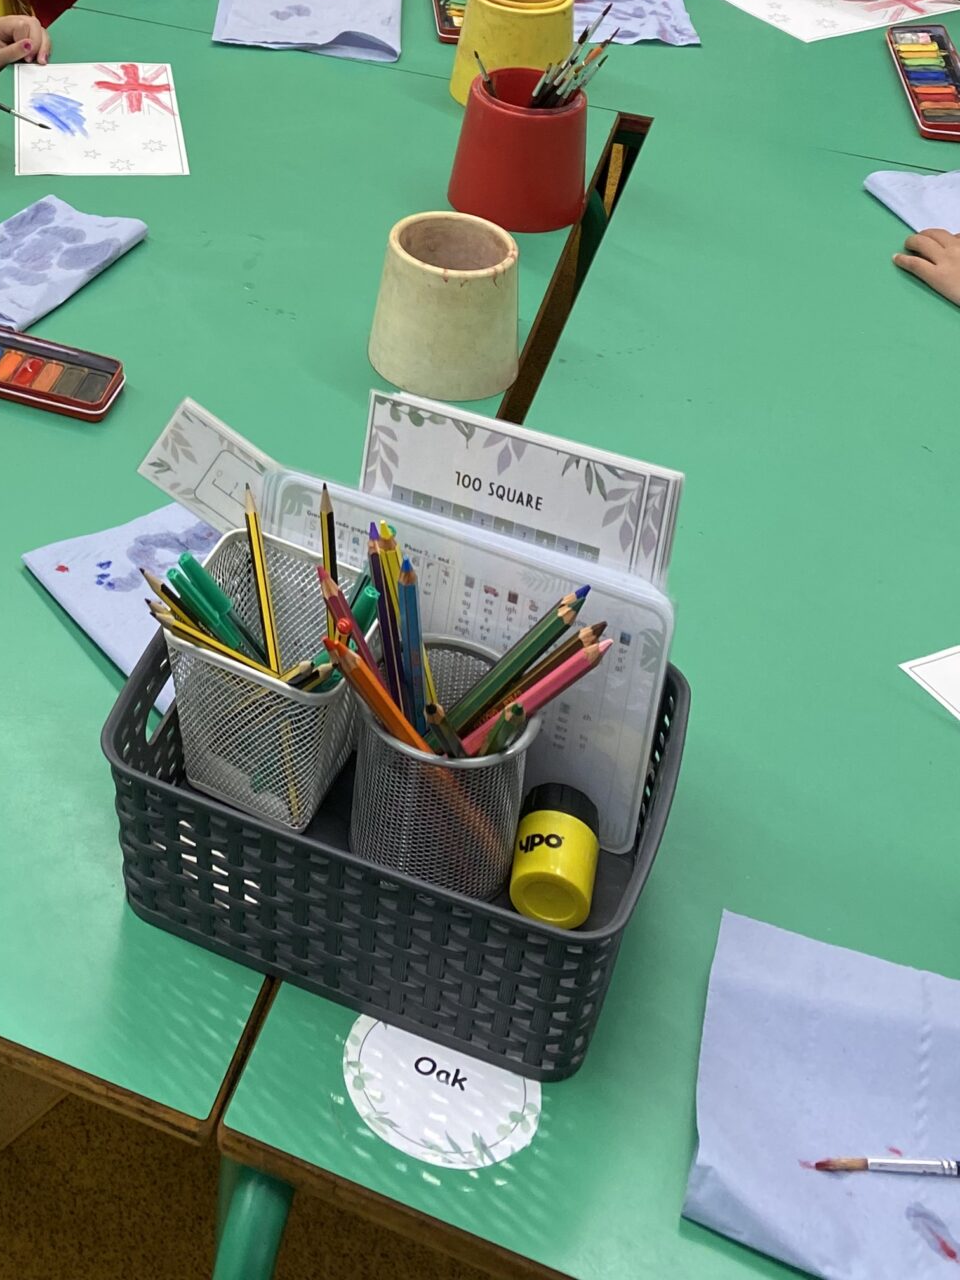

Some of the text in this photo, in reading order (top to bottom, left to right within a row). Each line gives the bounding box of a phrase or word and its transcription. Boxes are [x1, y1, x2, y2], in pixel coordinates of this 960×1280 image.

[455, 471, 544, 511] 100 SQUARE
[414, 1056, 468, 1091] Oak
